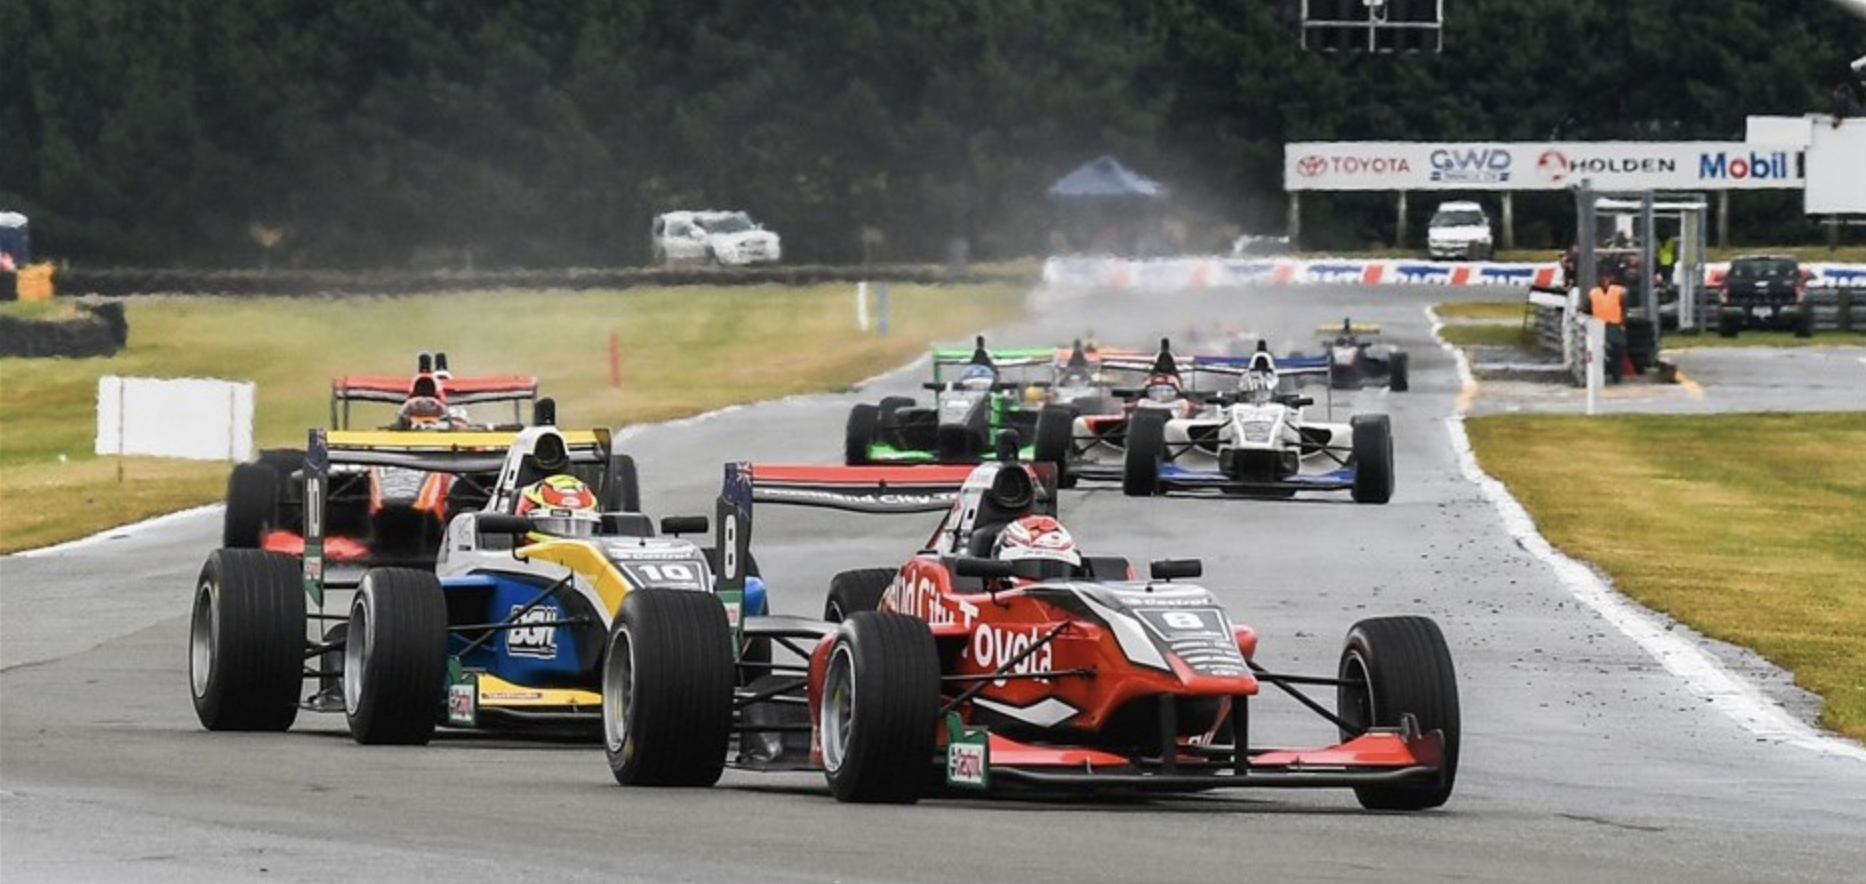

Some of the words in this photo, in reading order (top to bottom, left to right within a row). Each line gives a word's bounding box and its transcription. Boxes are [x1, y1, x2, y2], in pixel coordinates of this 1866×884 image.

[1333, 156, 1410, 173] TOYOTA
[1569, 157, 1676, 173] HOLDEN
[1699, 152, 1787, 179] Mobil
[306, 476, 320, 538] 10
[724, 513, 737, 580] 8
[638, 564, 694, 581] 10
[958, 600, 1053, 687] Toyota
